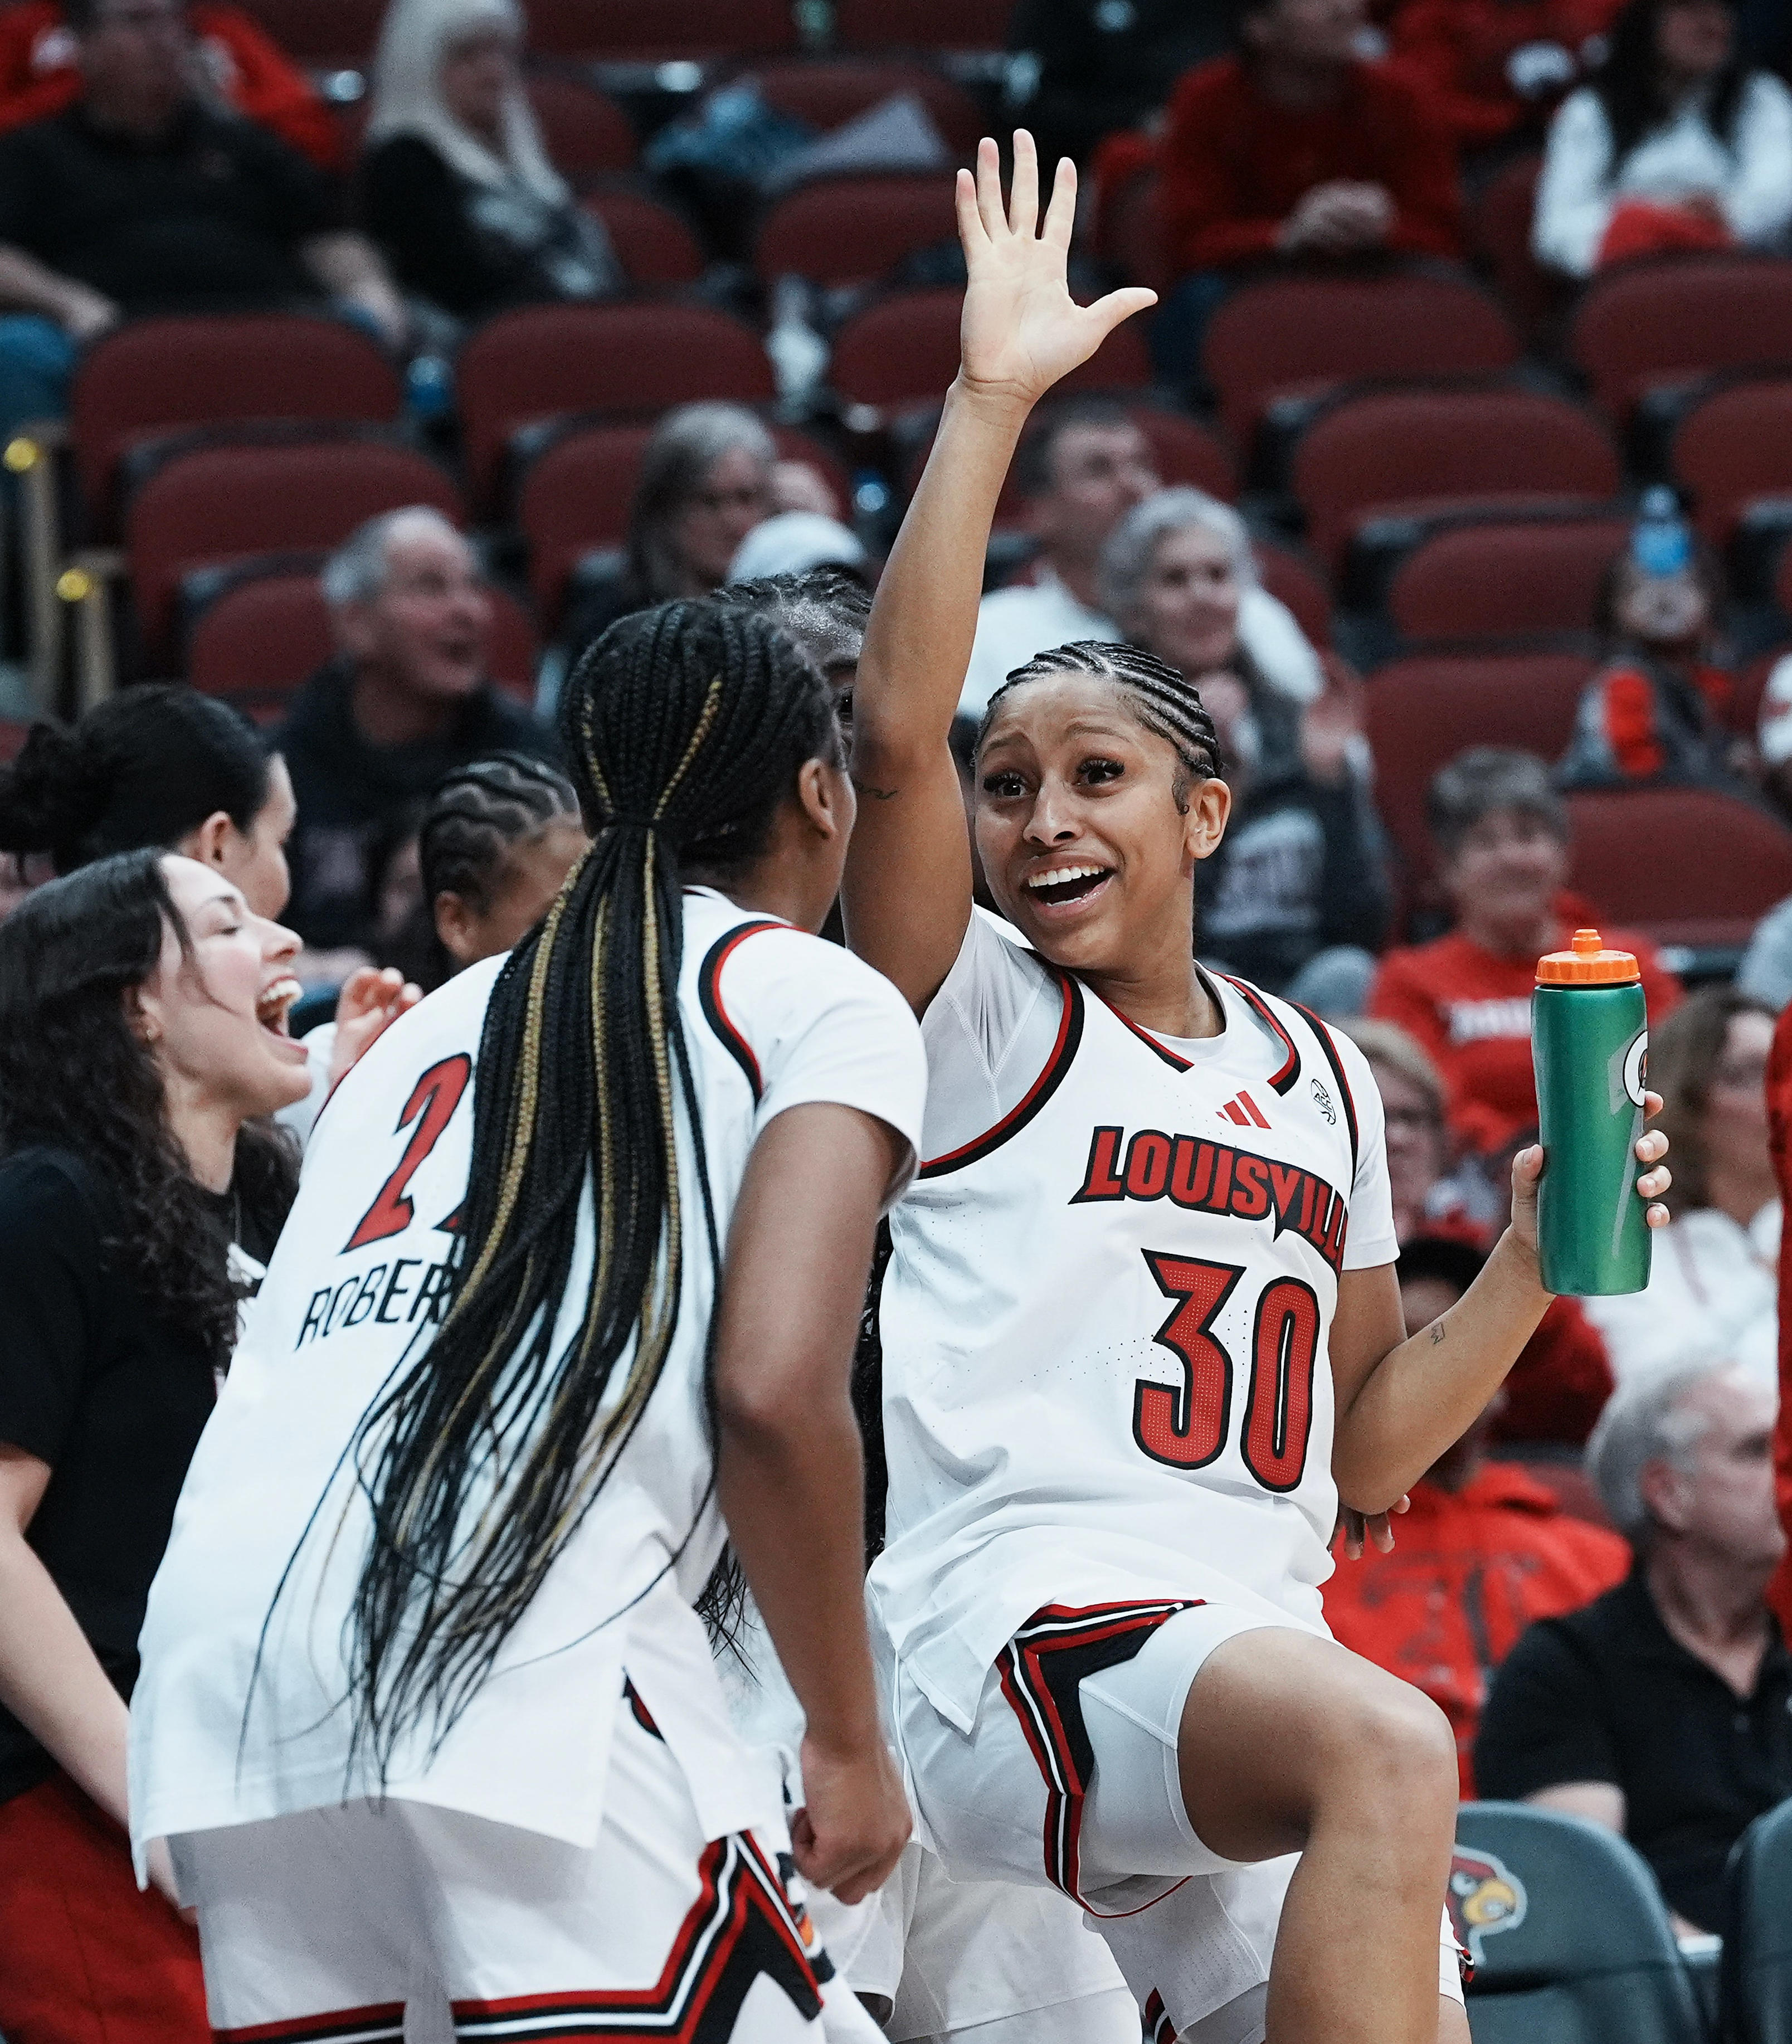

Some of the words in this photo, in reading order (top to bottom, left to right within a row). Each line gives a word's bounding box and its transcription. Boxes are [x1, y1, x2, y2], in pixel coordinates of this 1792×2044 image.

[337, 1052, 471, 1255] 2
[293, 1258, 455, 1351] ROBER
[1133, 1248, 1319, 1493] 30
